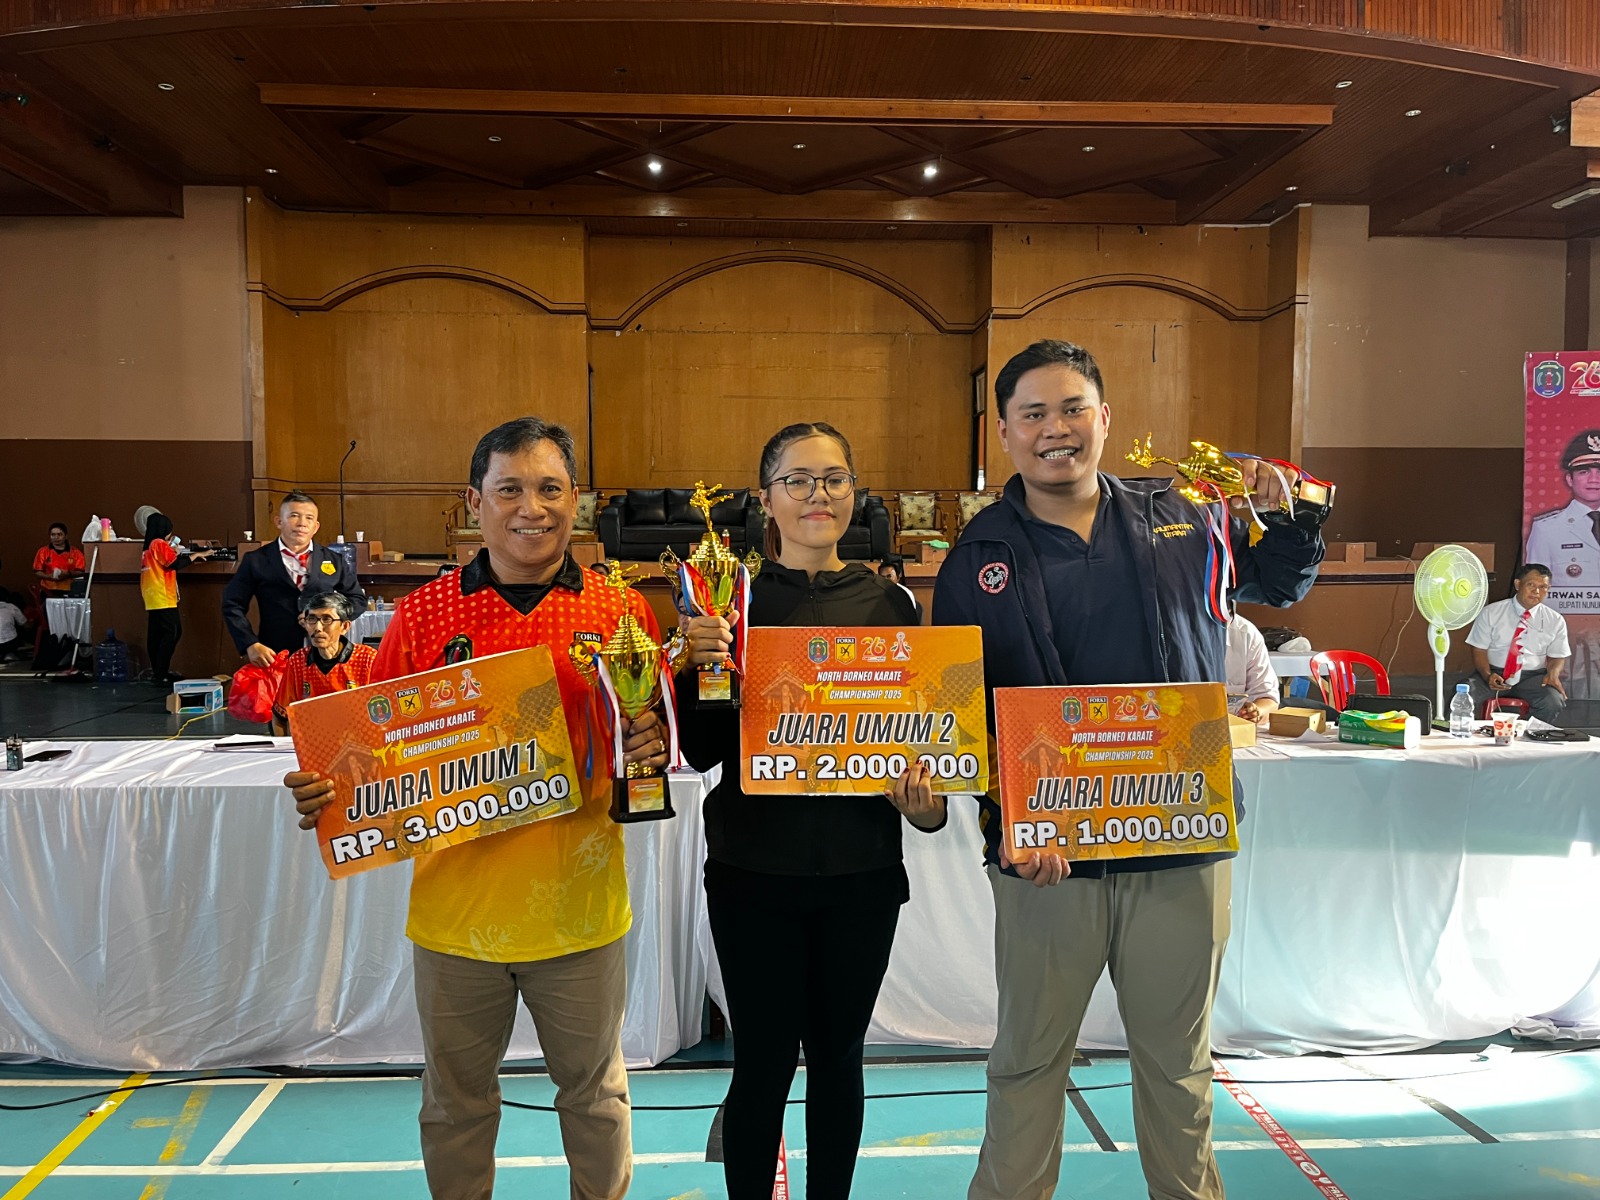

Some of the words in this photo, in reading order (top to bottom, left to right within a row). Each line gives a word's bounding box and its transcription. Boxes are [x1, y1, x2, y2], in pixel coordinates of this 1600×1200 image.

[1547, 591, 1584, 599] IRWAN
[1558, 601, 1581, 609] BUPATI
[861, 636, 887, 657] 26
[816, 671, 842, 682] NORTH
[843, 671, 873, 682] BORNEO
[873, 670, 902, 682] KARATE
[425, 679, 455, 704] 26
[829, 689, 883, 700] CHAMPIONSHIP
[883, 689, 902, 699] 2025
[1112, 695, 1138, 717] 26
[384, 725, 412, 744] NORTH
[412, 716, 446, 737] BORNEO
[446, 709, 477, 729] KARATE
[768, 712, 847, 745] JUARA
[854, 711, 936, 745] UMUM
[938, 711, 955, 744] 2
[1071, 732, 1097, 744] NORTH
[1096, 731, 1126, 744] BORNEO
[1126, 730, 1154, 742] KARATE
[402, 733, 460, 759] CHAMPIONSHIP
[460, 728, 481, 744] 2025
[751, 753, 807, 780] RP.
[816, 752, 979, 780] 2.000000
[1085, 752, 1137, 763] CHAMPIONSHIP
[1136, 749, 1155, 761] 2025
[347, 767, 433, 822] JUARA
[439, 743, 519, 795] UMUM
[525, 738, 538, 773] 1
[1028, 775, 1104, 811] JUARA
[1109, 772, 1186, 807] UMUM
[1190, 771, 1205, 804] 3
[330, 828, 398, 865] RP.
[403, 773, 570, 844] 3.000.000
[1013, 820, 1068, 849] RP.
[1077, 811, 1229, 845] 1.000.000
[1259, 1113, 1286, 1135] FRAGILE
